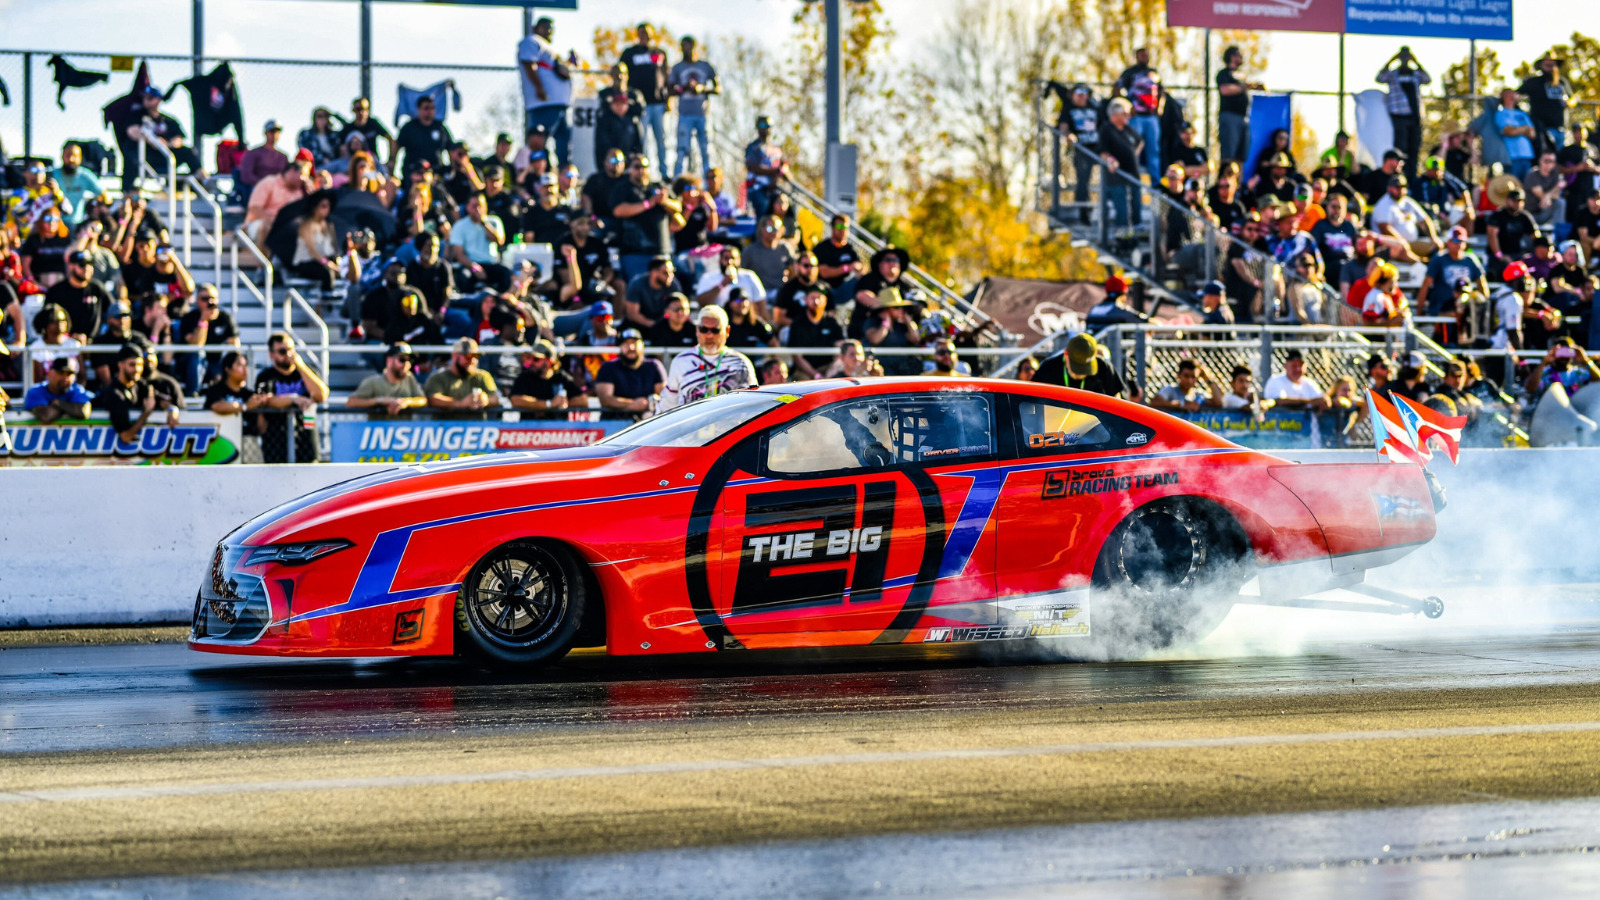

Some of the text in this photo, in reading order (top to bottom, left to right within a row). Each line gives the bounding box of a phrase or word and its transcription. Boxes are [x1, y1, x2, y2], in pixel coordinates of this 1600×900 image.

[1347, 7, 1425, 25] Responsibility
[1426, 12, 1446, 24] has
[574, 107, 602, 127] SE
[359, 426, 598, 451] INSINGER PERFORMANCE
[1069, 471, 1179, 497] RACING TEAM
[748, 526, 883, 563] THE BIG
[1030, 622, 1089, 636] Haltech
